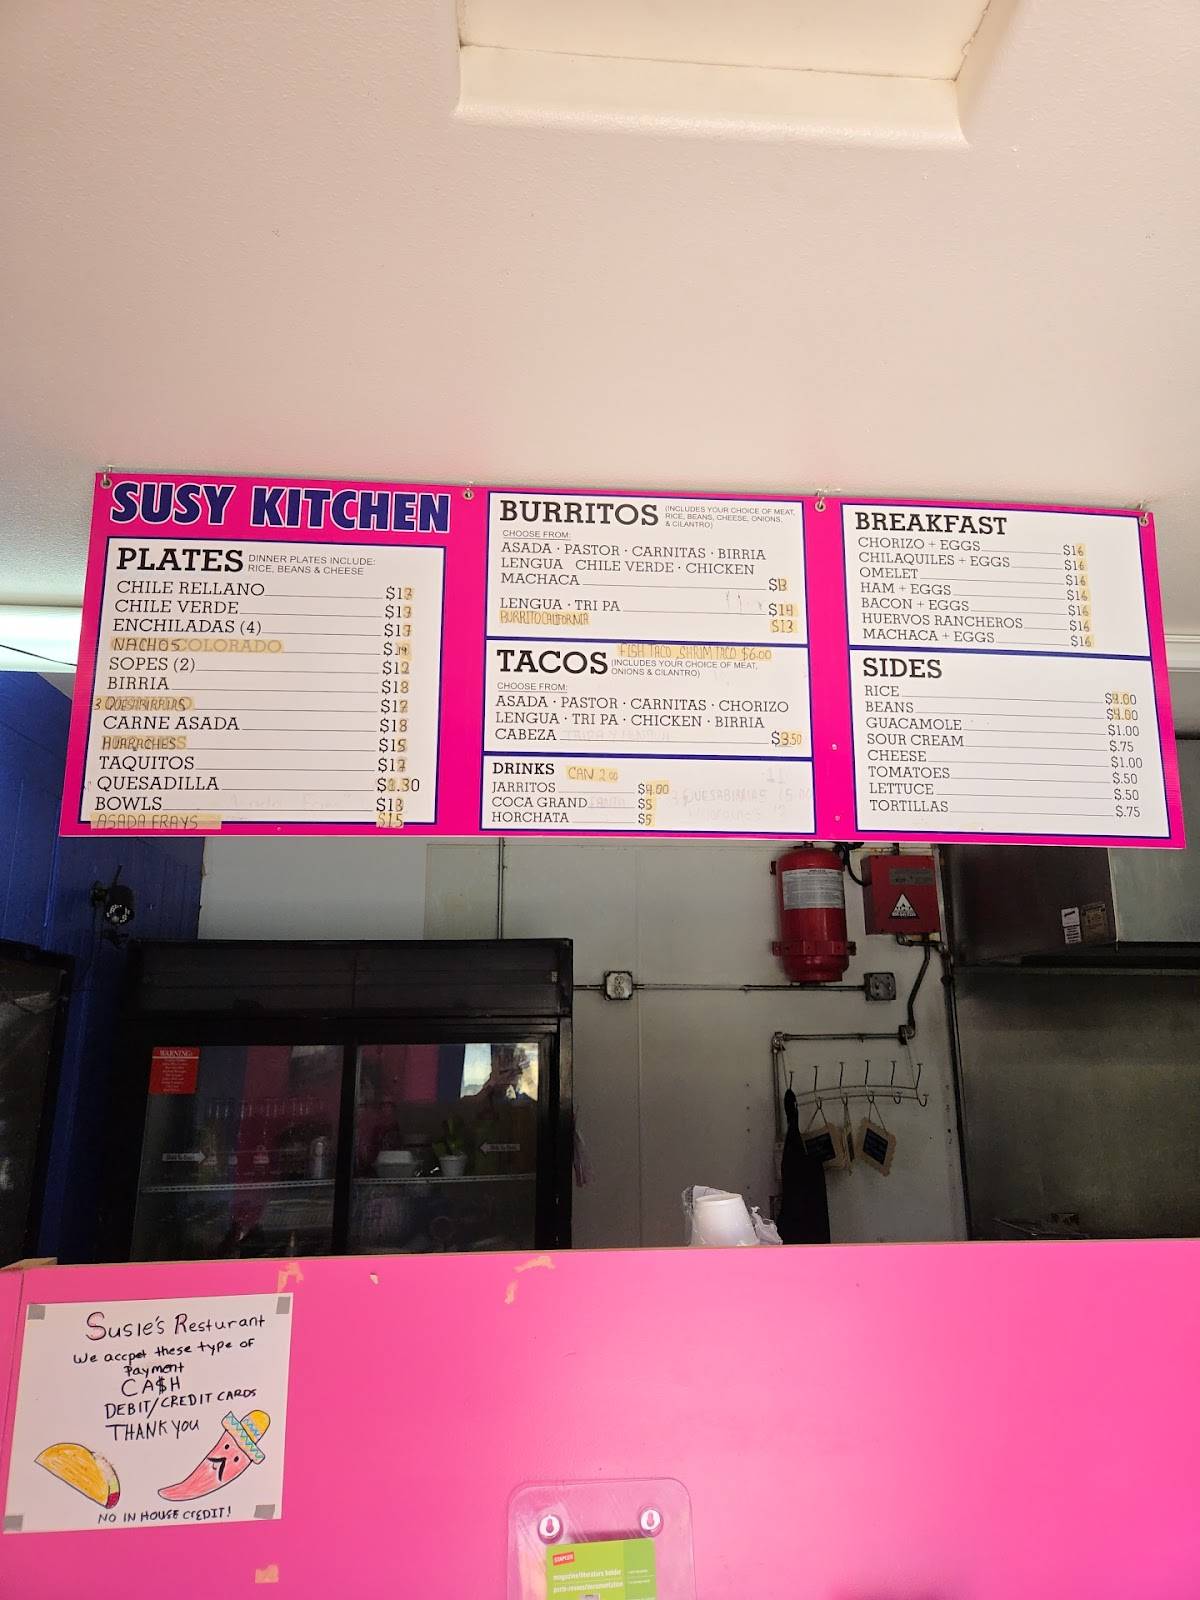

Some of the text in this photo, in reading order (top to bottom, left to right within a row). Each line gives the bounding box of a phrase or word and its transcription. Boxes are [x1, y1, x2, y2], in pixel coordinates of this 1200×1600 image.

[109, 480, 451, 533] SUSY KITCHEN
[500, 500, 659, 526] BURRITOS
[665, 505, 704, 513] (INCLUDES
[665, 513, 685, 521] RICE,
[687, 514, 712, 522] BEANS,
[673, 521, 713, 529] CILANTRO)
[856, 512, 1007, 535] BREAKFAST
[503, 530, 540, 538] CHOOSE
[501, 543, 766, 560] ASADA PASTOR CARNITAS BIRRIA
[858, 537, 924, 550] CHORIZO
[940, 540, 980, 552] EGGS
[116, 547, 244, 573] PLATES
[248, 554, 376, 566] DINNER PLATES INCLUDE:
[501, 558, 754, 575] LENGUA CHILE VERDE CHICKEN
[859, 552, 955, 566] CHILAQUILES
[971, 556, 1010, 568] EGGS
[248, 564, 364, 575] RICE, BEANS & CHEESE
[860, 568, 918, 579] OMELET
[501, 573, 579, 586] MACHACA
[117, 580, 265, 597] CHILE RELLANO
[861, 583, 894, 593] HAM
[911, 584, 951, 596] EGGS
[115, 600, 239, 615] CHILE VERDE
[500, 598, 562, 610] LENGUA
[575, 599, 598, 611] TRI
[602, 600, 620, 611] PA
[861, 598, 912, 609] BACON
[929, 600, 969, 611] EGGS
[113, 619, 261, 637] ENCHILADAS (4)
[863, 613, 930, 625] HUERVOS
[935, 615, 1023, 629] RANCHEROS
[863, 629, 938, 641] MACHACA
[954, 631, 994, 643] EGGS
[109, 657, 195, 673] SOPES (2)
[497, 650, 608, 674] TACOS
[611, 659, 656, 668] (INCLUDES
[659, 660, 682, 668] YOUR
[684, 661, 718, 669] CHOICE
[863, 658, 942, 679] SIDES
[611, 668, 644, 676] ONIONS
[655, 669, 700, 677] CILANTRO)
[108, 676, 169, 691] BIRRIA
[497, 683, 567, 691] CHOOSE FROM:
[865, 685, 899, 697] RICE
[496, 696, 789, 713] ASADA PASTOR CARNITAS CHORIZO
[866, 701, 914, 713] BEANS
[103, 716, 169, 730] CARNE
[175, 717, 239, 731] ASADA
[496, 712, 764, 728] LENGUA TRI PA CHICKEN BIRRIA
[867, 718, 1139, 737] GUACAMOLE $1.00
[495, 728, 556, 741] CABEZA
[867, 734, 1134, 753] SOUR CREAM $.75
[100, 755, 194, 771] TAQUITOS
[868, 750, 1143, 769] CHEESE $1.00
[493, 763, 594, 780] DRINKS CAN
[869, 766, 1137, 785] TOMATOES $.50
[97, 776, 219, 792] QUESADILLA
[492, 781, 555, 794] JARRITOS
[870, 783, 1139, 801] LETTUCE $.50
[95, 796, 162, 811] BOWLS
[492, 796, 532, 808] COCA
[537, 797, 588, 808] GRAND
[870, 800, 1140, 818] TORTILLAS $.75
[96, 814, 403, 829] ASADA FRAYS $15
[492, 812, 569, 823] HORCHATA
[175, 1314, 265, 1334] Resturant
[74, 1353, 97, 1364] We
[155, 1345, 192, 1357] these
[197, 1341, 232, 1355] type
[121, 1376, 180, 1396] CA$H
[105, 1393, 212, 1419] DEBIT/CREDIT
[105, 1422, 167, 1441] THANK
[98, 1513, 116, 1524] NO
[124, 1511, 136, 1521] IN
